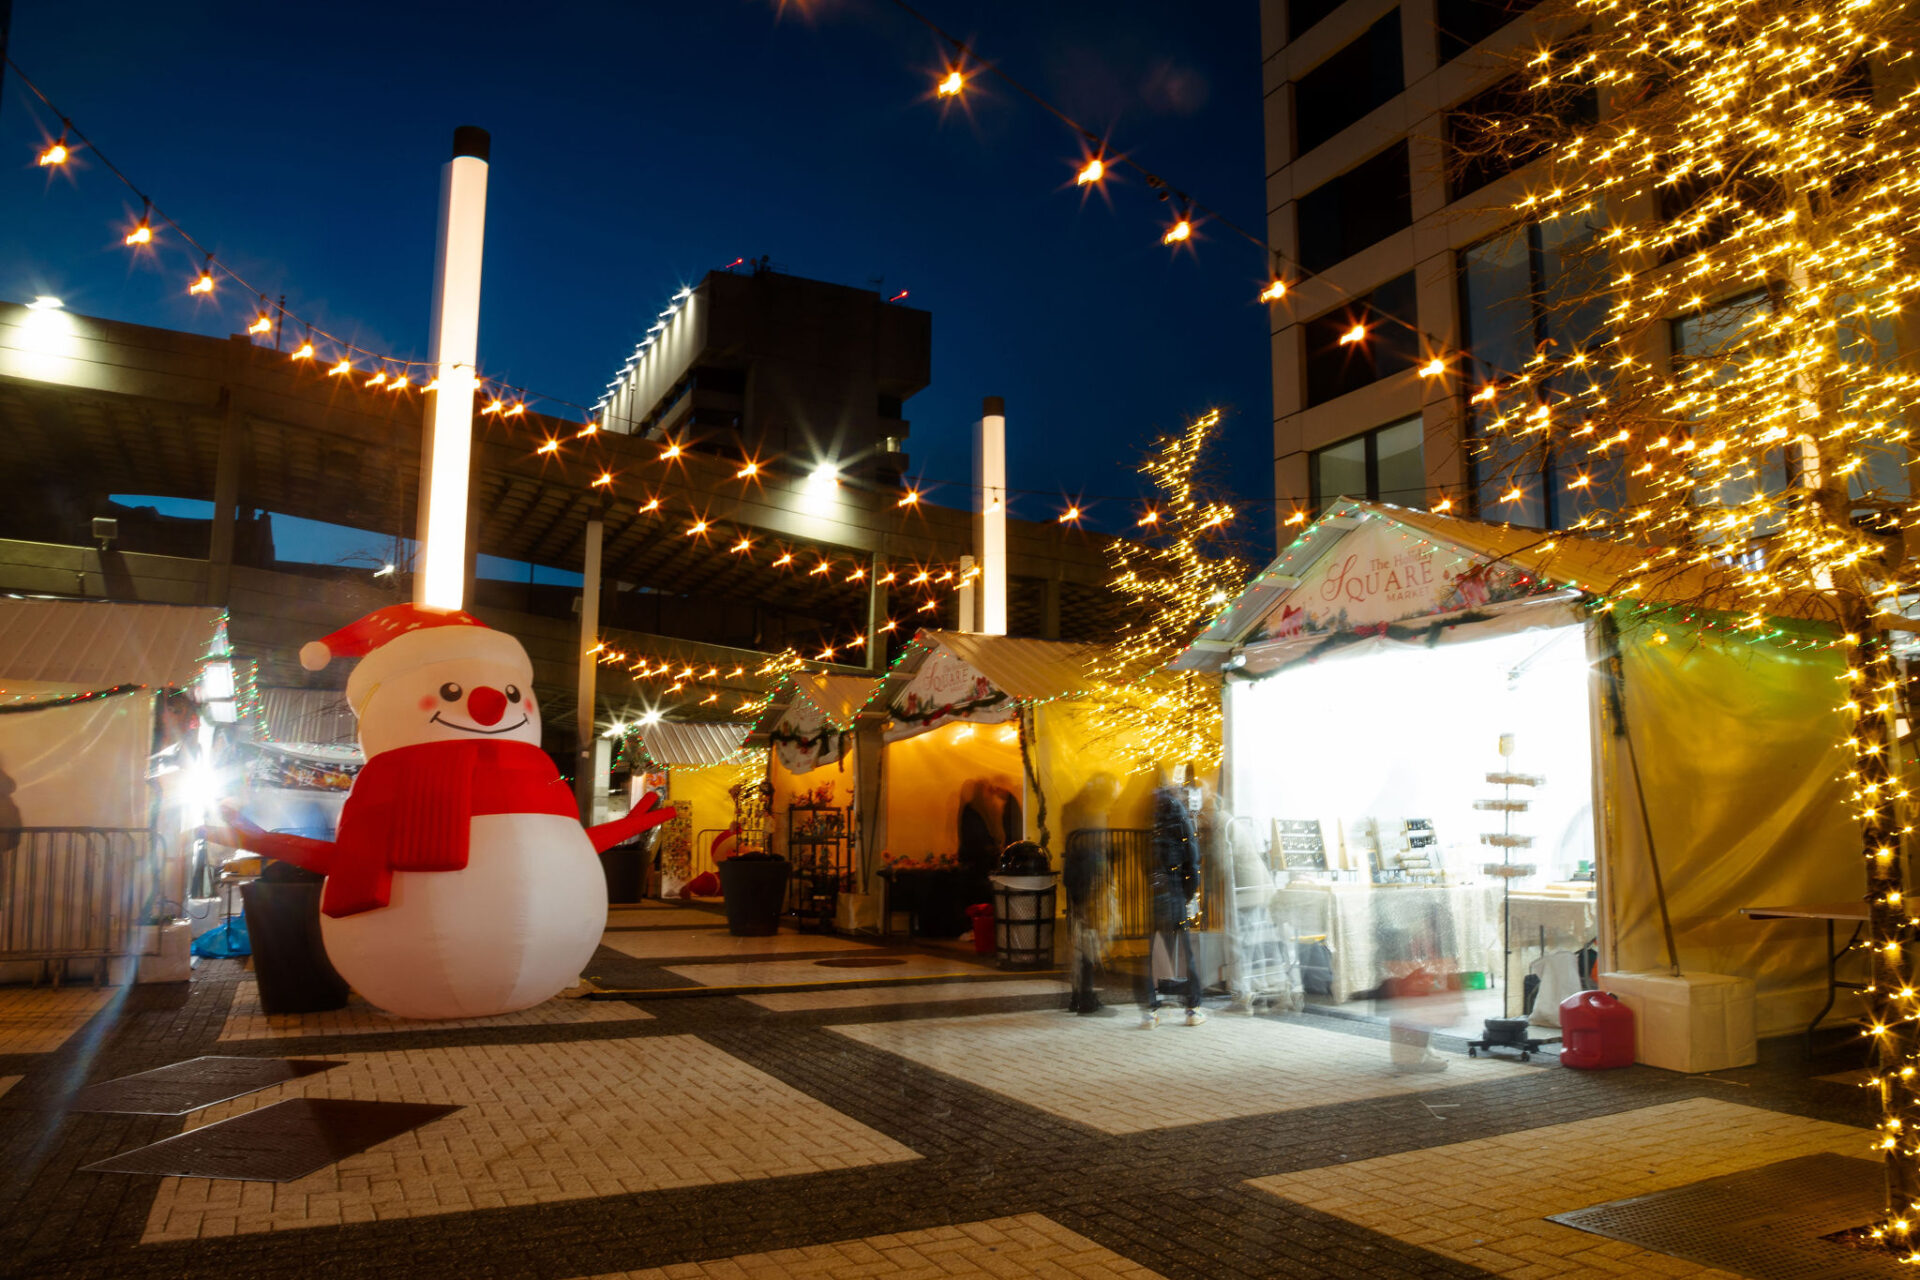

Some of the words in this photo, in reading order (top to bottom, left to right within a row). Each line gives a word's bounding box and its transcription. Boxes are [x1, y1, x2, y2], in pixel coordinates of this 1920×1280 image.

[1370, 558, 1390, 572] The
[1320, 554, 1434, 603] SQUARE
[1386, 586, 1430, 602] MARKET
